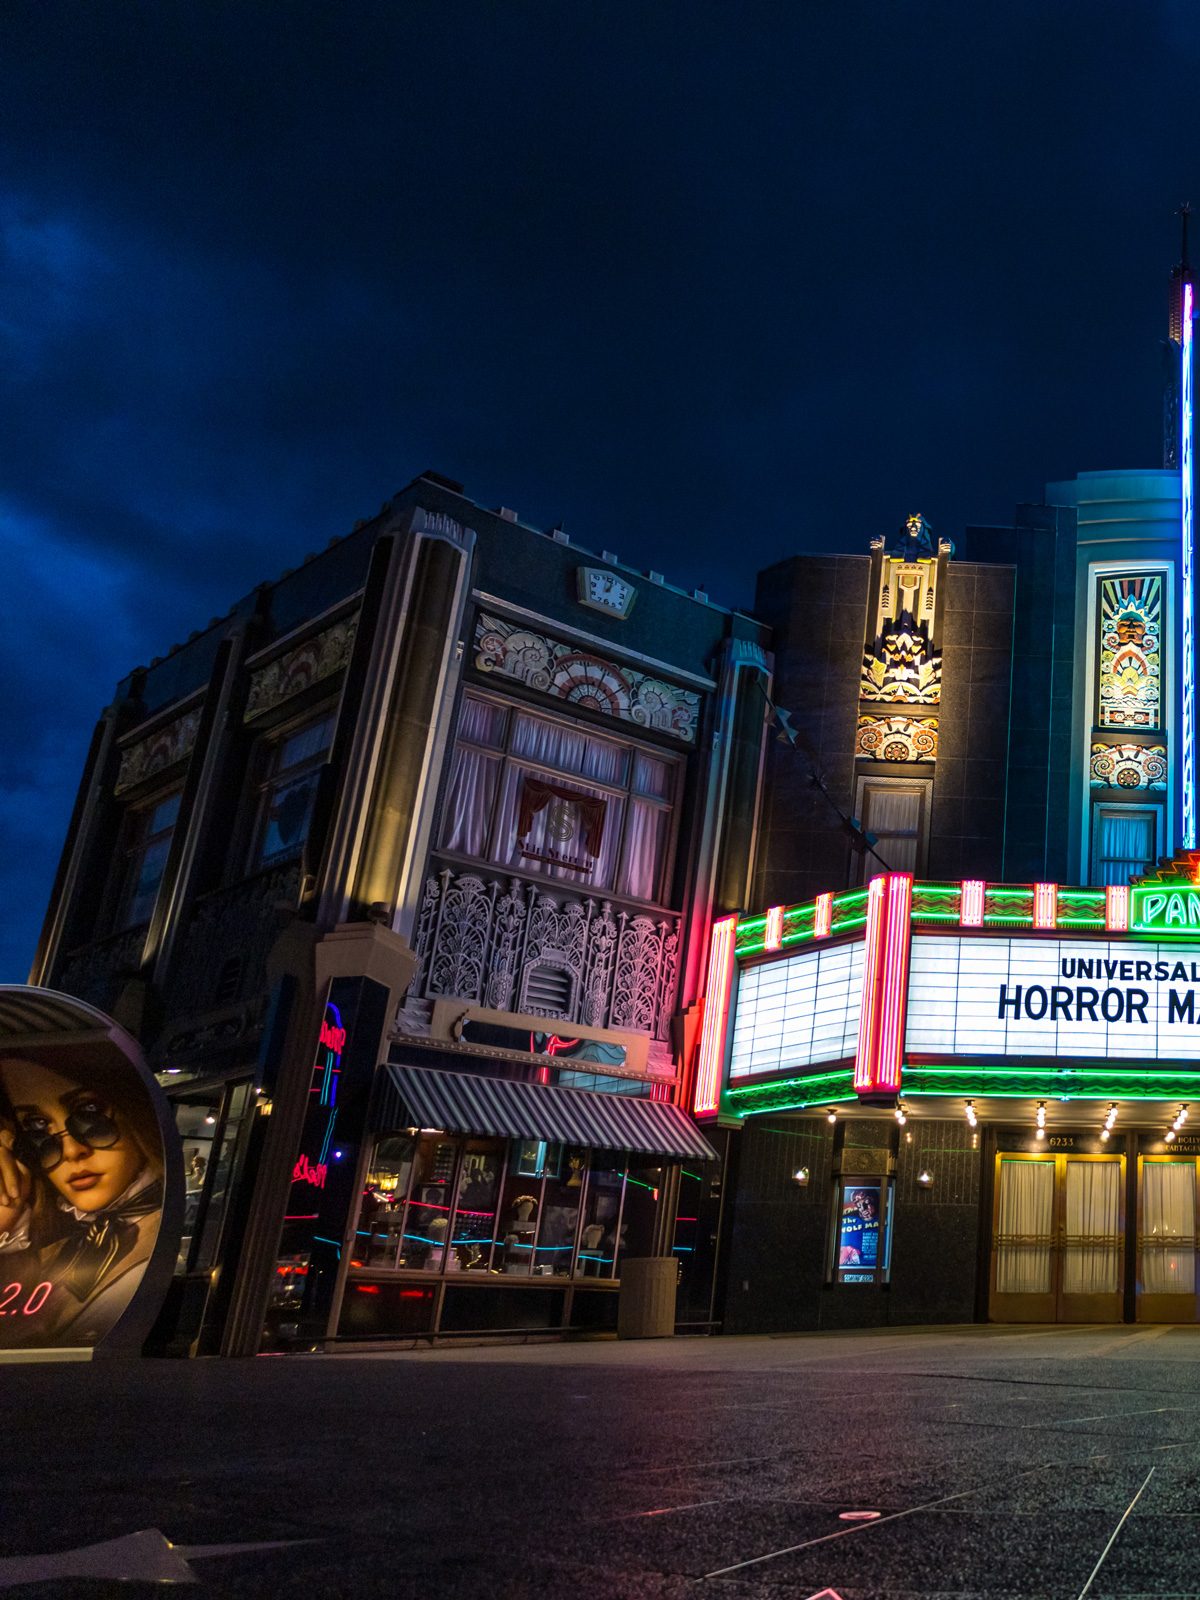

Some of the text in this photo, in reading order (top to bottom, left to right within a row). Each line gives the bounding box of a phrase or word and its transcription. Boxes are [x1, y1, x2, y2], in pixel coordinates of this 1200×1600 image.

[998, 984, 1150, 1024] HORROR
[1049, 1137, 1074, 1147] 6233
[0, 1281, 53, 1315] 2.0
